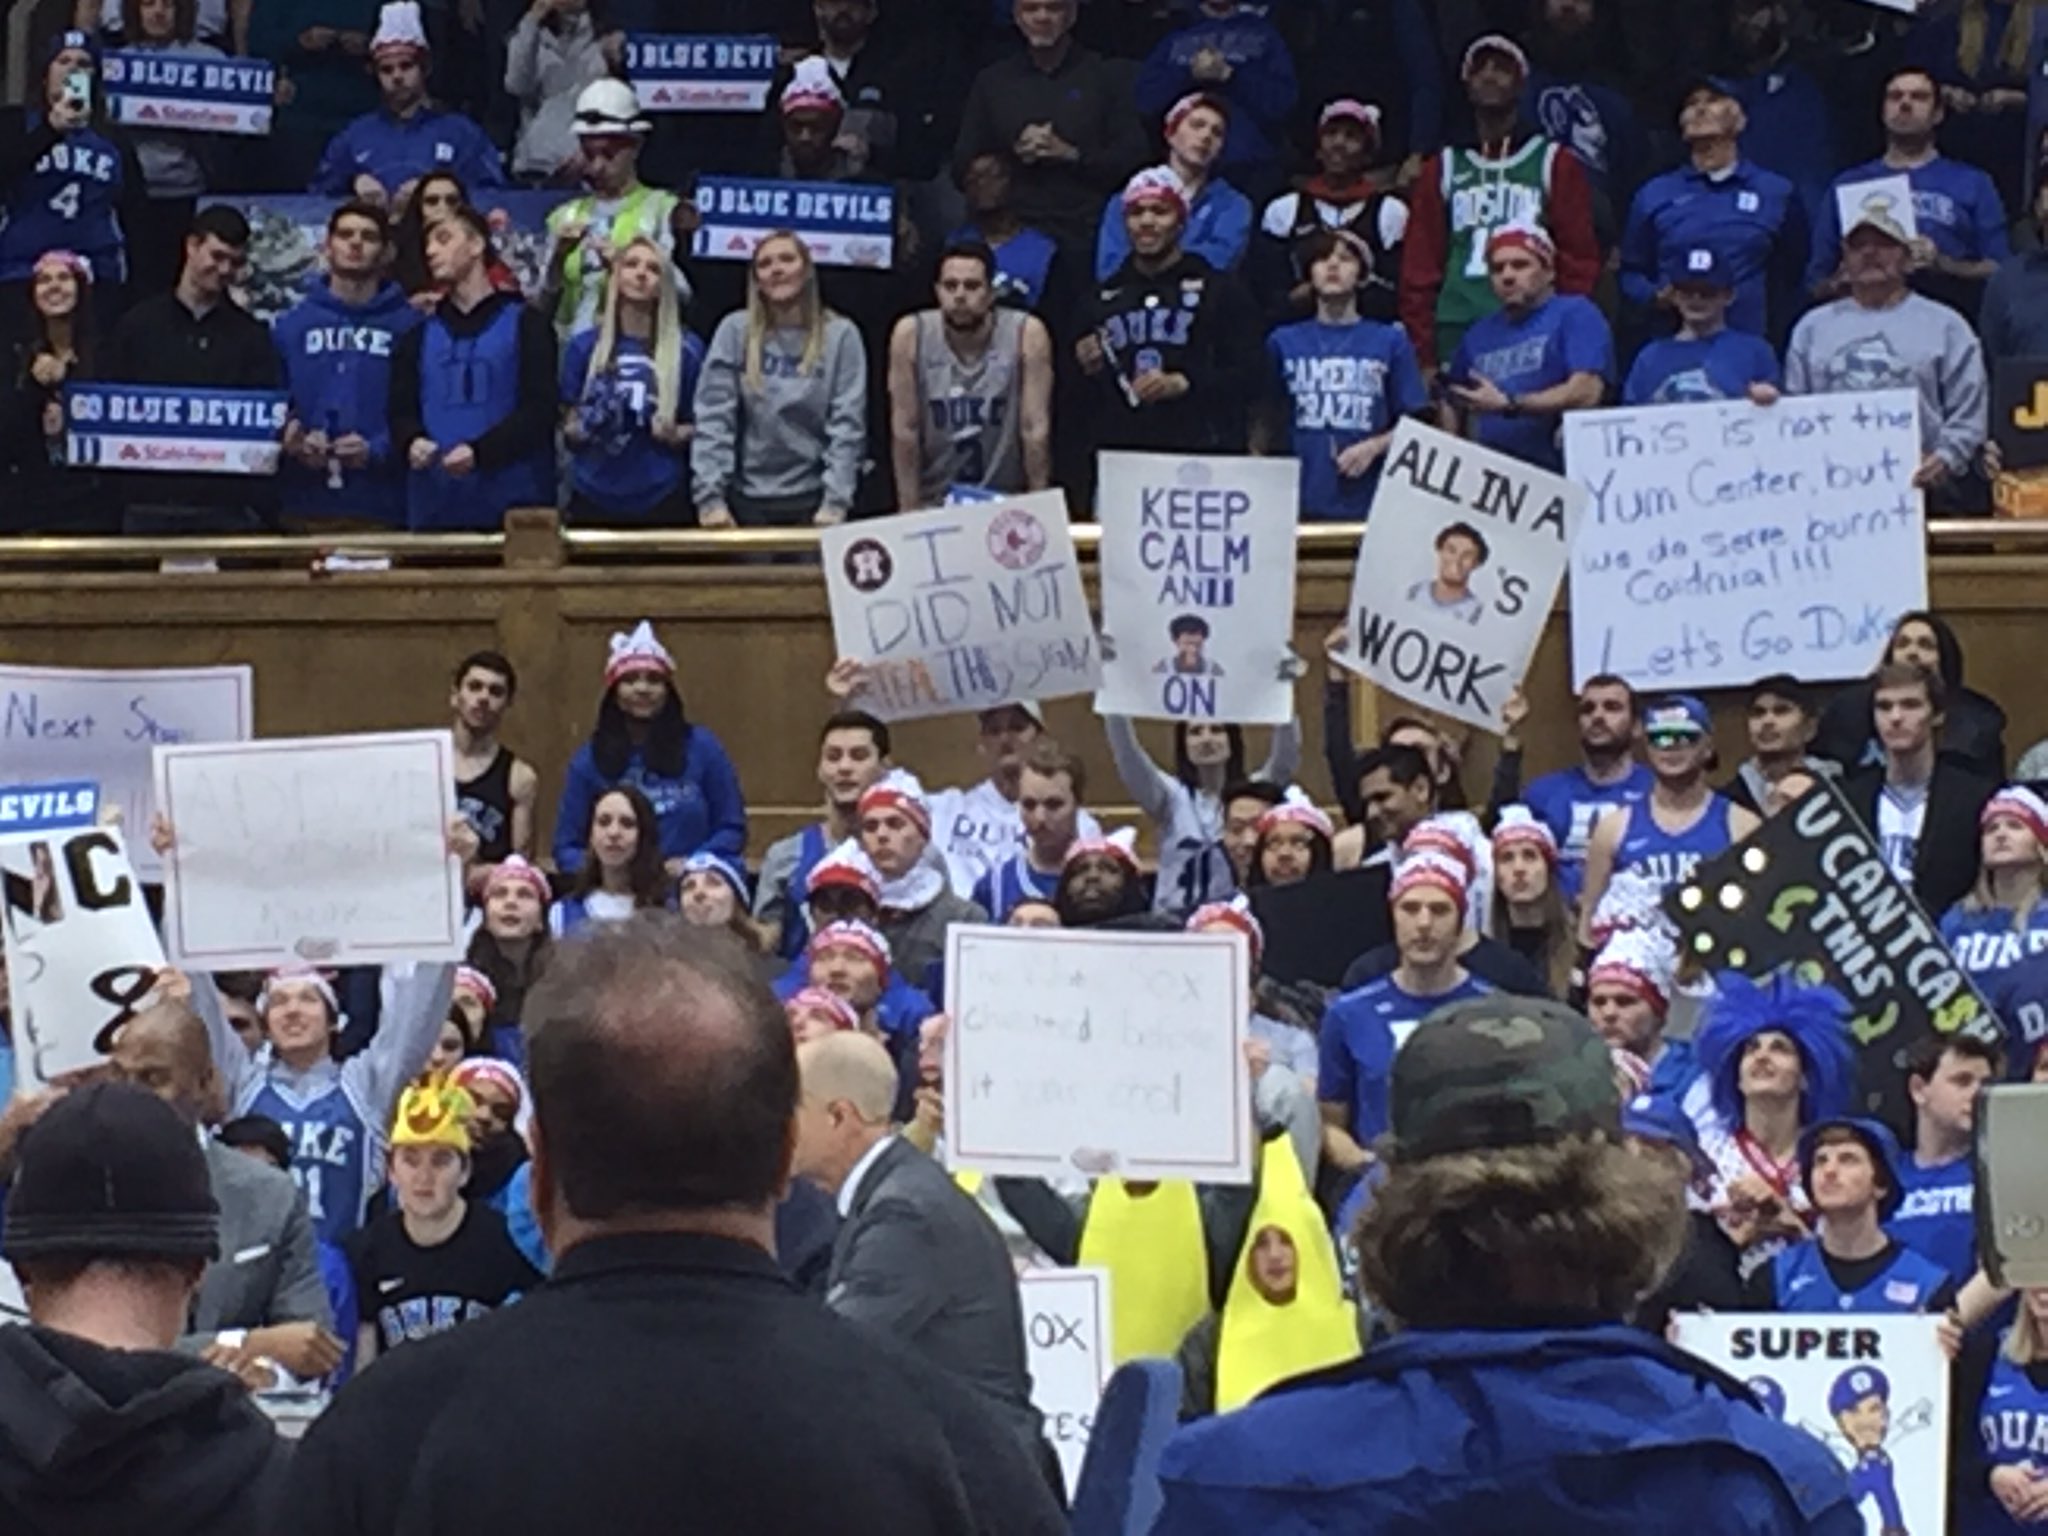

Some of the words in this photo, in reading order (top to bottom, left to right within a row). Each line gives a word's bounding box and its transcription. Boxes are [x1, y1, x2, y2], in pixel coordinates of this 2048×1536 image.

[130, 60, 198, 88] BLUE
[642, 42, 708, 69] BLUE
[49, 182, 81, 219] 4
[719, 186, 790, 216] BLUE
[795, 192, 892, 223] DEVILS
[305, 331, 393, 357] DUKE
[108, 396, 181, 425] BLUE
[187, 399, 289, 429] DEVILS
[1580, 412, 1689, 459] This
[1721, 407, 1754, 447] is
[1778, 407, 1834, 439] not
[1852, 401, 1913, 434] the
[1386, 437, 1463, 505] ALL
[1471, 467, 1529, 525] IN
[1531, 496, 1566, 542] A
[1584, 468, 1677, 526] Yum
[1824, 447, 1902, 490] but
[1140, 489, 1250, 532] KEEP
[903, 525, 975, 589] I
[1139, 533, 1251, 575] CALM
[1582, 549, 1631, 575] we
[1646, 534, 1688, 566] do
[1806, 494, 1915, 545] burnt
[866, 590, 971, 655] DID
[1602, 620, 1724, 679] Let's
[1740, 609, 1794, 662] Go
[1357, 605, 1508, 718] WORK
[5, 692, 96, 740] Next
[1163, 676, 1217, 718] ON
[1796, 792, 1842, 838] U
[1822, 834, 1933, 959] CANT
[1810, 892, 1894, 997] THIS
[1029, 1311, 1088, 1351] OX
[1730, 1327, 1883, 1360] SUPER
